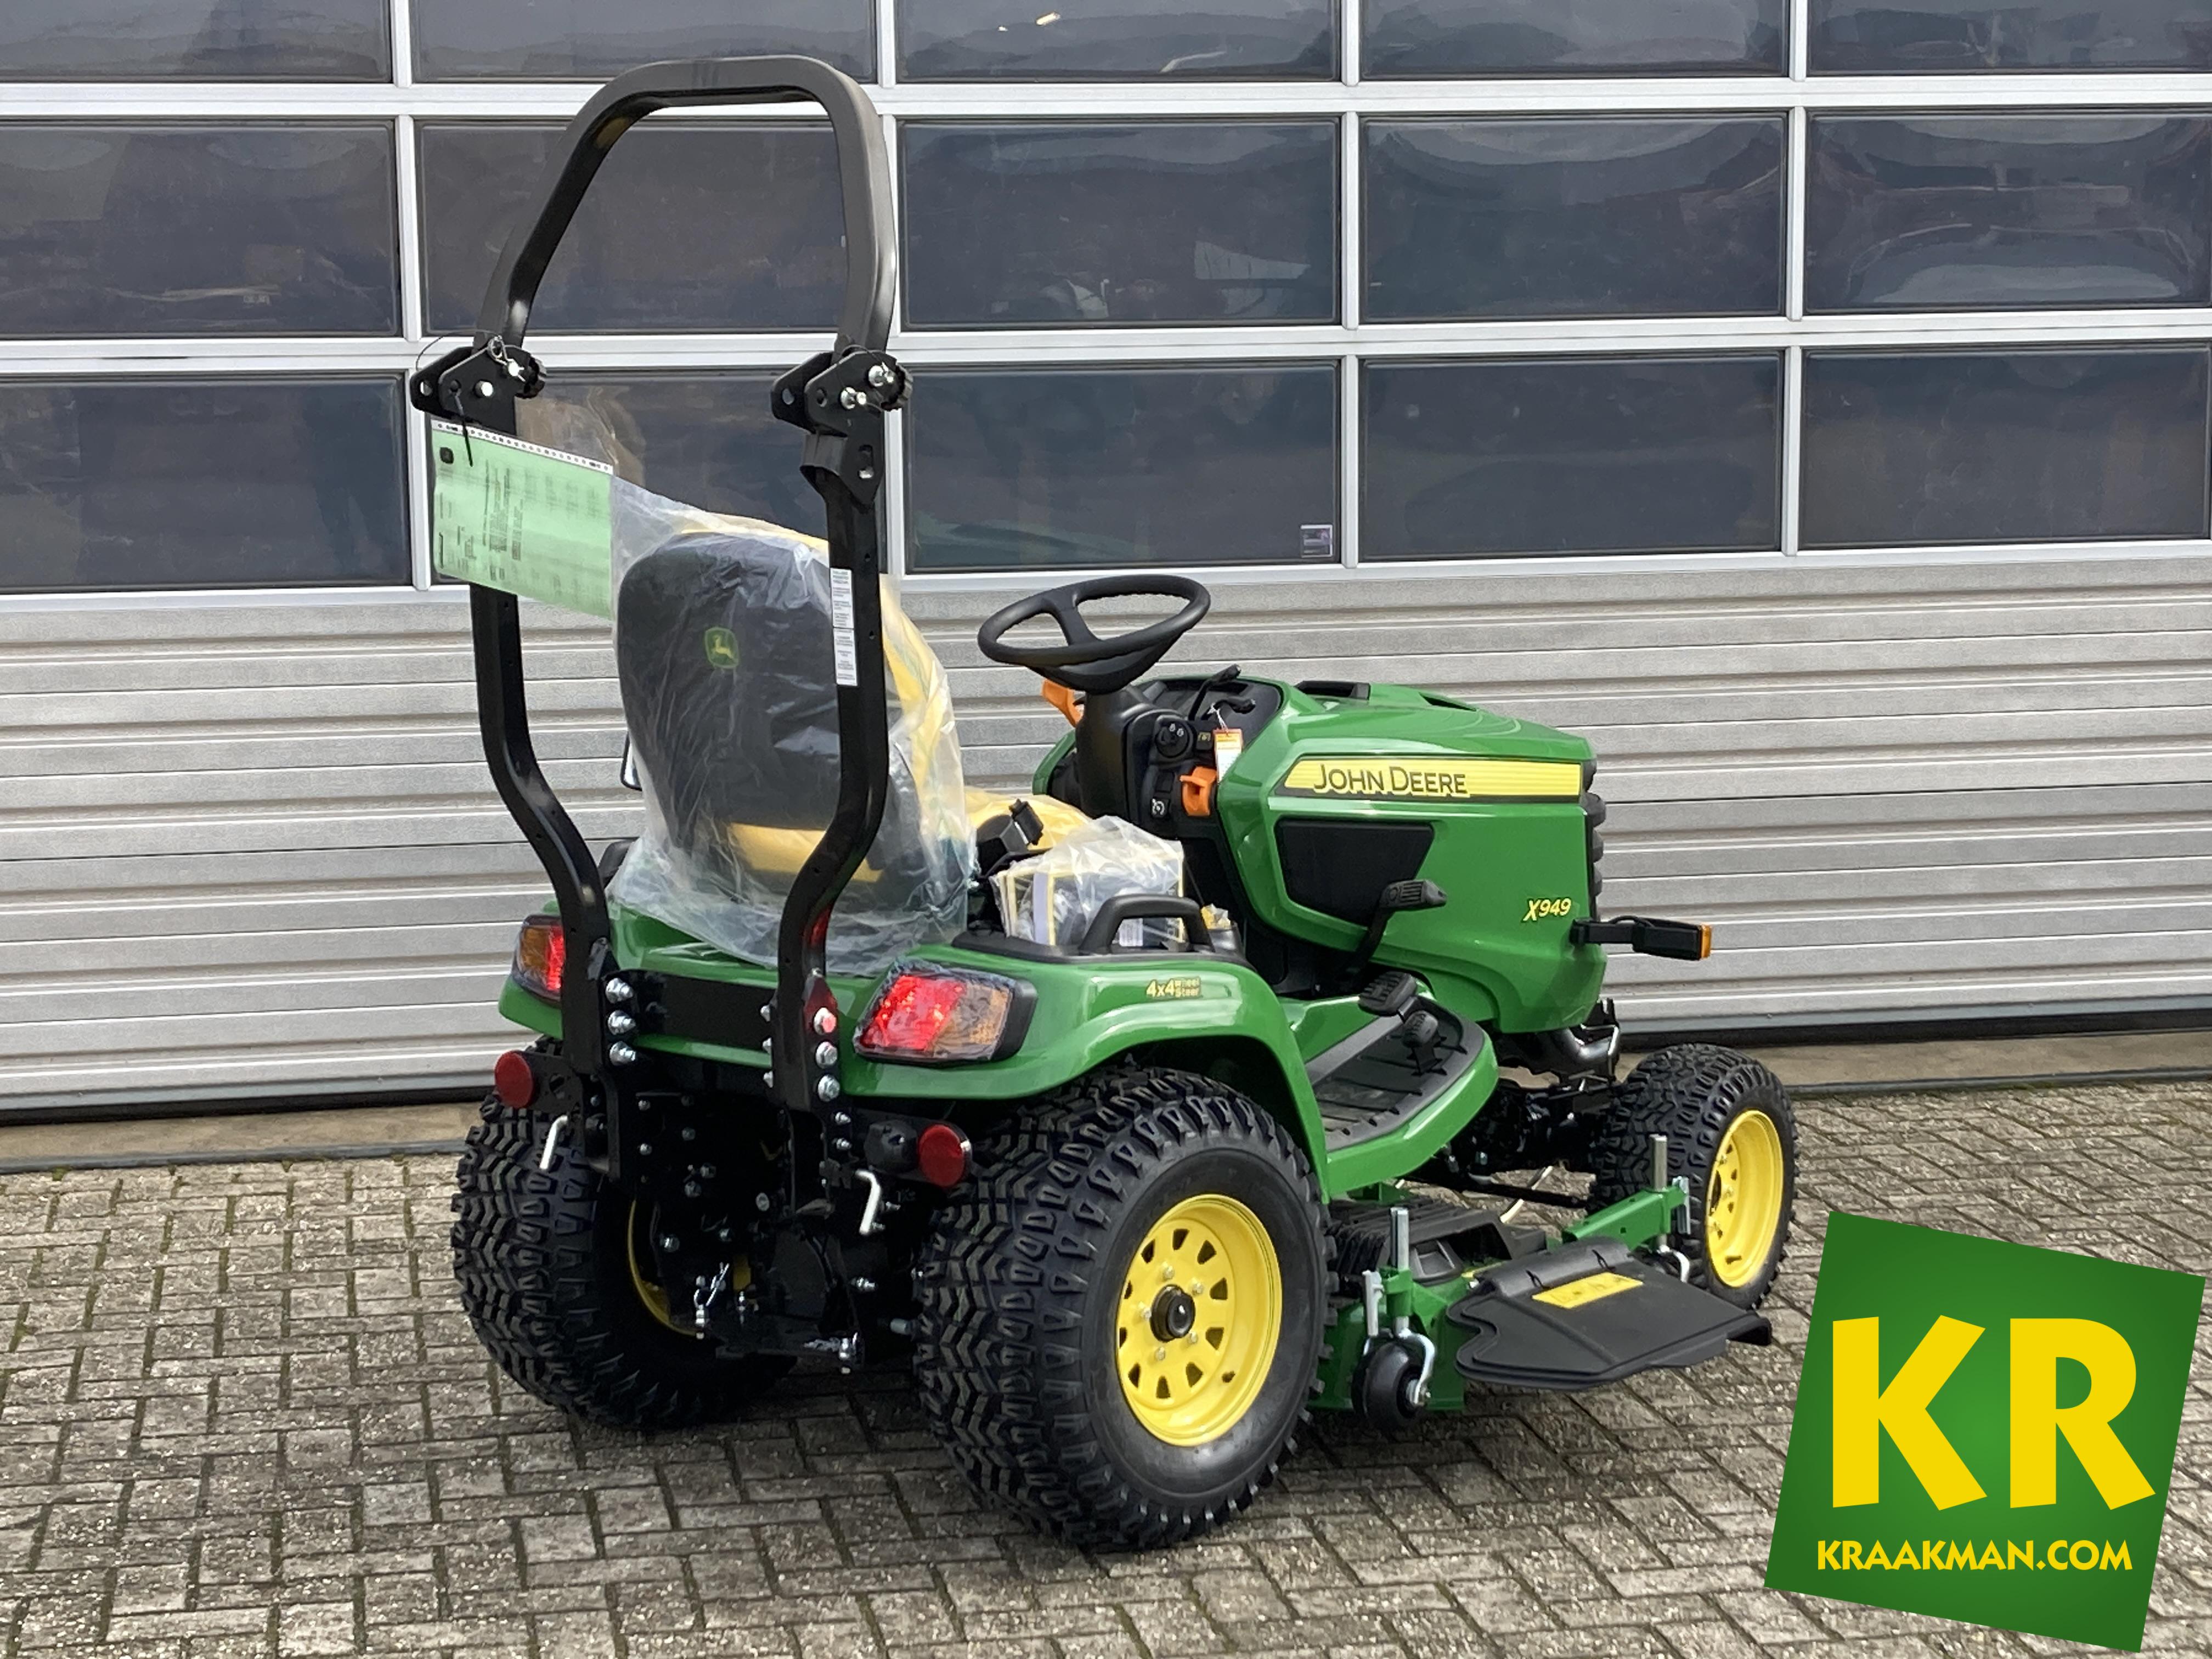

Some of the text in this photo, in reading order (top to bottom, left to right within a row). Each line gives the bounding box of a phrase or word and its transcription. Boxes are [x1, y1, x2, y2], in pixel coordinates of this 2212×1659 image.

[1314, 764, 1468, 794] JOHN DEERE
[1522, 898, 1572, 921] X949
[1146, 979, 1174, 997] 4x4
